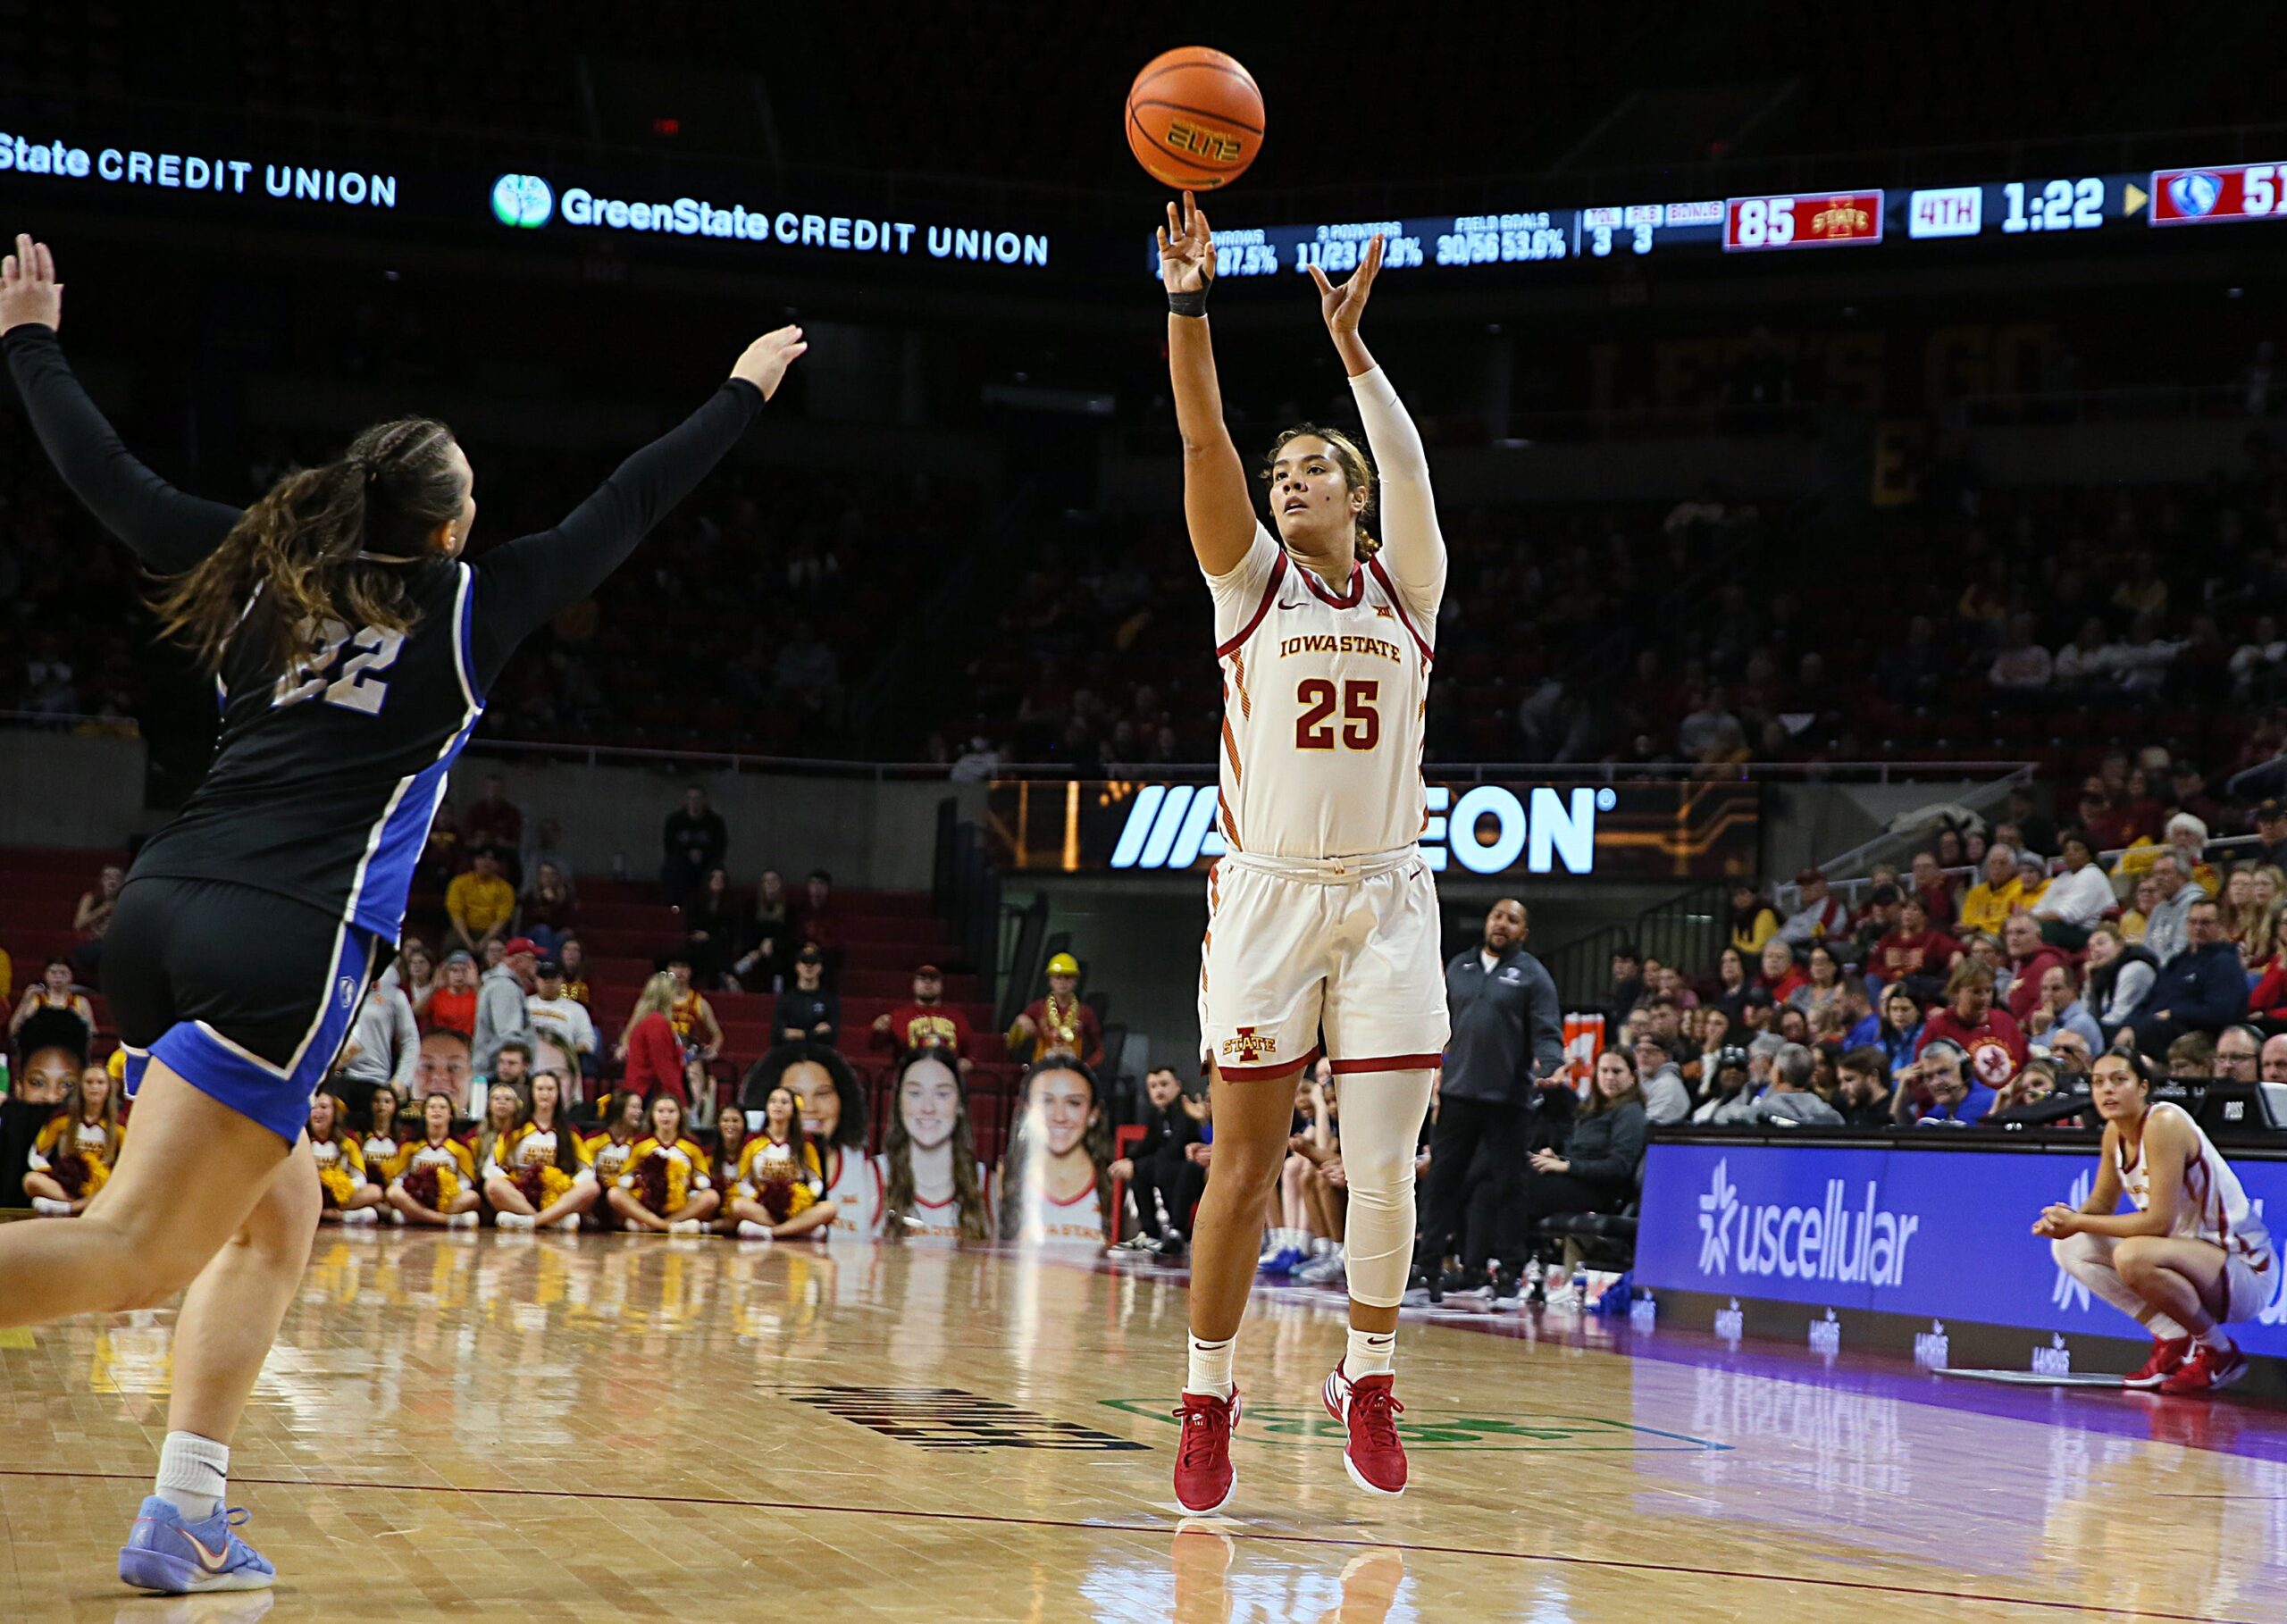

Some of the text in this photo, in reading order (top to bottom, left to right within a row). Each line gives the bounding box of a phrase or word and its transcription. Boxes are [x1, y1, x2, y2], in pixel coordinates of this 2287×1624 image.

[1166, 123, 1242, 162] ELITE
[97, 147, 253, 193] CREDIT
[264, 163, 398, 209] UNION
[1454, 215, 1499, 233] FIELD
[1738, 197, 1796, 247] 85
[1920, 196, 1973, 225] 4TH
[2002, 178, 2104, 233] 1:22
[560, 187, 1050, 267] GreenState CREDIT UNION
[1591, 225, 1613, 257] 3
[1632, 223, 1654, 255] 3
[1294, 239, 1357, 273] 11/23
[1436, 231, 1500, 266] 30/56
[270, 617, 407, 715] 22
[1295, 678, 1380, 750] 25
[1222, 1036, 1276, 1055] STATE
[1737, 1178, 1919, 1287] uscellular
